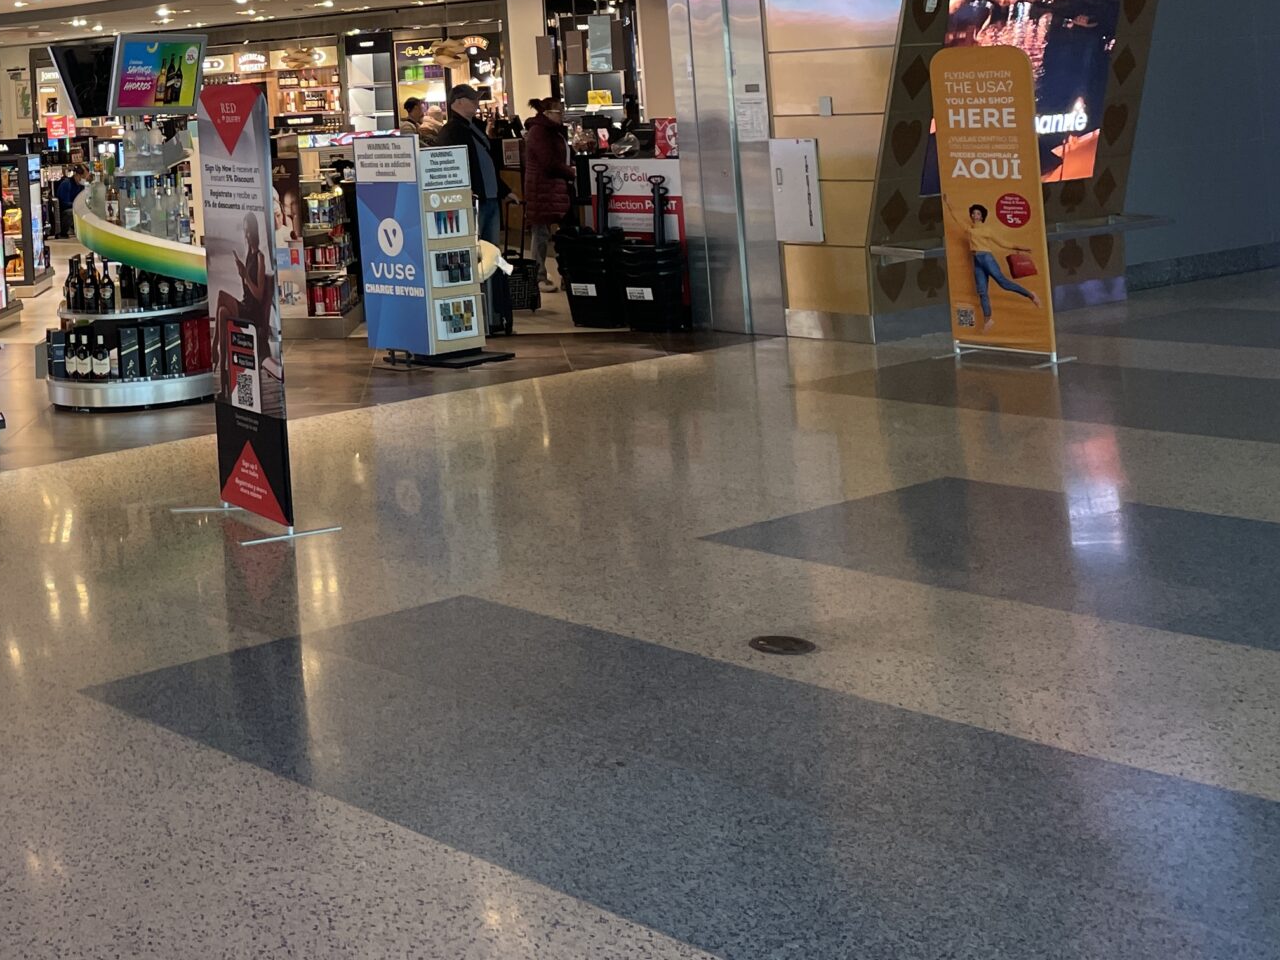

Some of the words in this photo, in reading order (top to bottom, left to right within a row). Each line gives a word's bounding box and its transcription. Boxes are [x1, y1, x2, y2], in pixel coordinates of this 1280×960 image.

[944, 71, 976, 80] FLYING
[977, 70, 1011, 79] WITHIN
[944, 82, 972, 94] THE
[976, 80, 1014, 94] USA?
[945, 97, 965, 105] YOU
[966, 97, 986, 105] CAN
[988, 96, 1015, 105] SHOP
[219, 102, 237, 114] RED
[948, 107, 1017, 129] HERE
[951, 154, 1023, 180] AQUÍ
[233, 175, 255, 183] Discount
[365, 283, 395, 296] CHARGE
[395, 285, 425, 298] BEYOND
